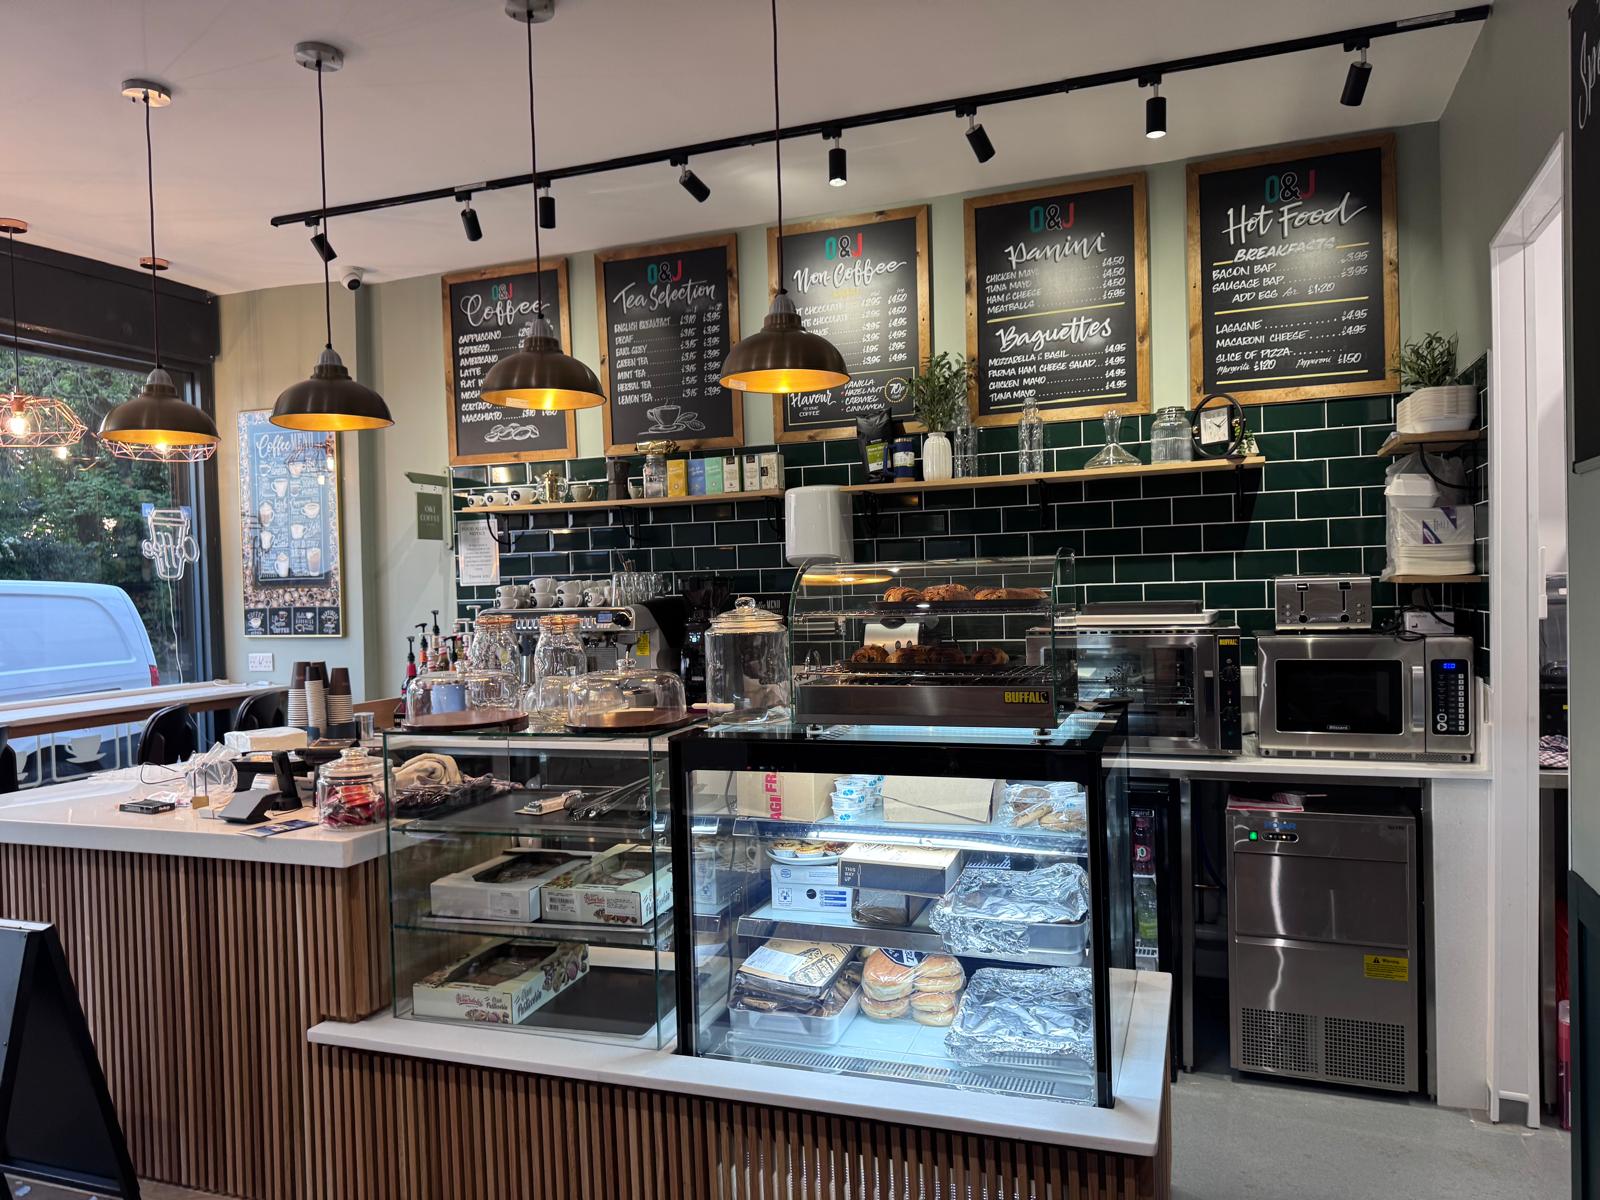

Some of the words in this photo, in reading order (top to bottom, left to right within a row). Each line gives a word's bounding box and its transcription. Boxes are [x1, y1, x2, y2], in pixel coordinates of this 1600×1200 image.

[1264, 169, 1318, 204] O&J
[1029, 202, 1076, 233] O&J
[1222, 204, 1274, 246] Hot
[1278, 191, 1368, 239] Food
[825, 232, 864, 260] O&J
[1004, 232, 1107, 270] Panini
[648, 259, 683, 284] O&J
[833, 259, 907, 288] Coffee
[986, 271, 1017, 284] CHICKEN
[1212, 265, 1250, 281] BACON
[1254, 262, 1277, 274] BAP
[986, 283, 1007, 294] TUNA
[1010, 280, 1033, 290] MAYO
[1212, 279, 1261, 294] SAUSAGE
[1263, 275, 1285, 287] BAP
[613, 282, 648, 314] Tea
[650, 278, 716, 311] Selection
[987, 294, 1005, 305] HAM
[1232, 292, 1256, 304] ADD
[1259, 289, 1279, 300] EGG
[460, 294, 550, 327] Coffee
[995, 315, 1113, 353] Baguettes
[1215, 320, 1263, 335] LASAGNE
[458, 330, 502, 345] CAPPUCCINO
[1215, 336, 1265, 349] MACARONI
[1270, 330, 1310, 343] CHEESE
[637, 357, 649, 366] TEA
[988, 354, 1037, 368] MOZZARELLA
[1044, 349, 1070, 360] BASIL
[1216, 352, 1242, 364] SLICE
[1244, 349, 1258, 360] OF
[1261, 348, 1293, 359] PIZZA
[460, 368, 482, 378] LATTE
[618, 371, 634, 380] MINT
[635, 369, 646, 378] TEA
[988, 367, 1016, 378] PARMA
[1018, 365, 1037, 375] HAM
[1039, 362, 1067, 373] CHEESE
[1069, 359, 1096, 370] SALAD
[641, 381, 652, 390] TEA
[845, 379, 875, 389] VANILLA
[989, 378, 1020, 390] CHICKEN
[1023, 376, 1047, 386] MAYO
[461, 390, 480, 400] MOCH
[618, 395, 640, 406] LEMON
[640, 393, 653, 402] TEA
[845, 395, 879, 405] CARAMEL
[990, 391, 1012, 402] TUNA
[1013, 389, 1037, 399] MAYO
[846, 403, 885, 413] CINNAMON
[462, 412, 503, 423] MACCHIATO
